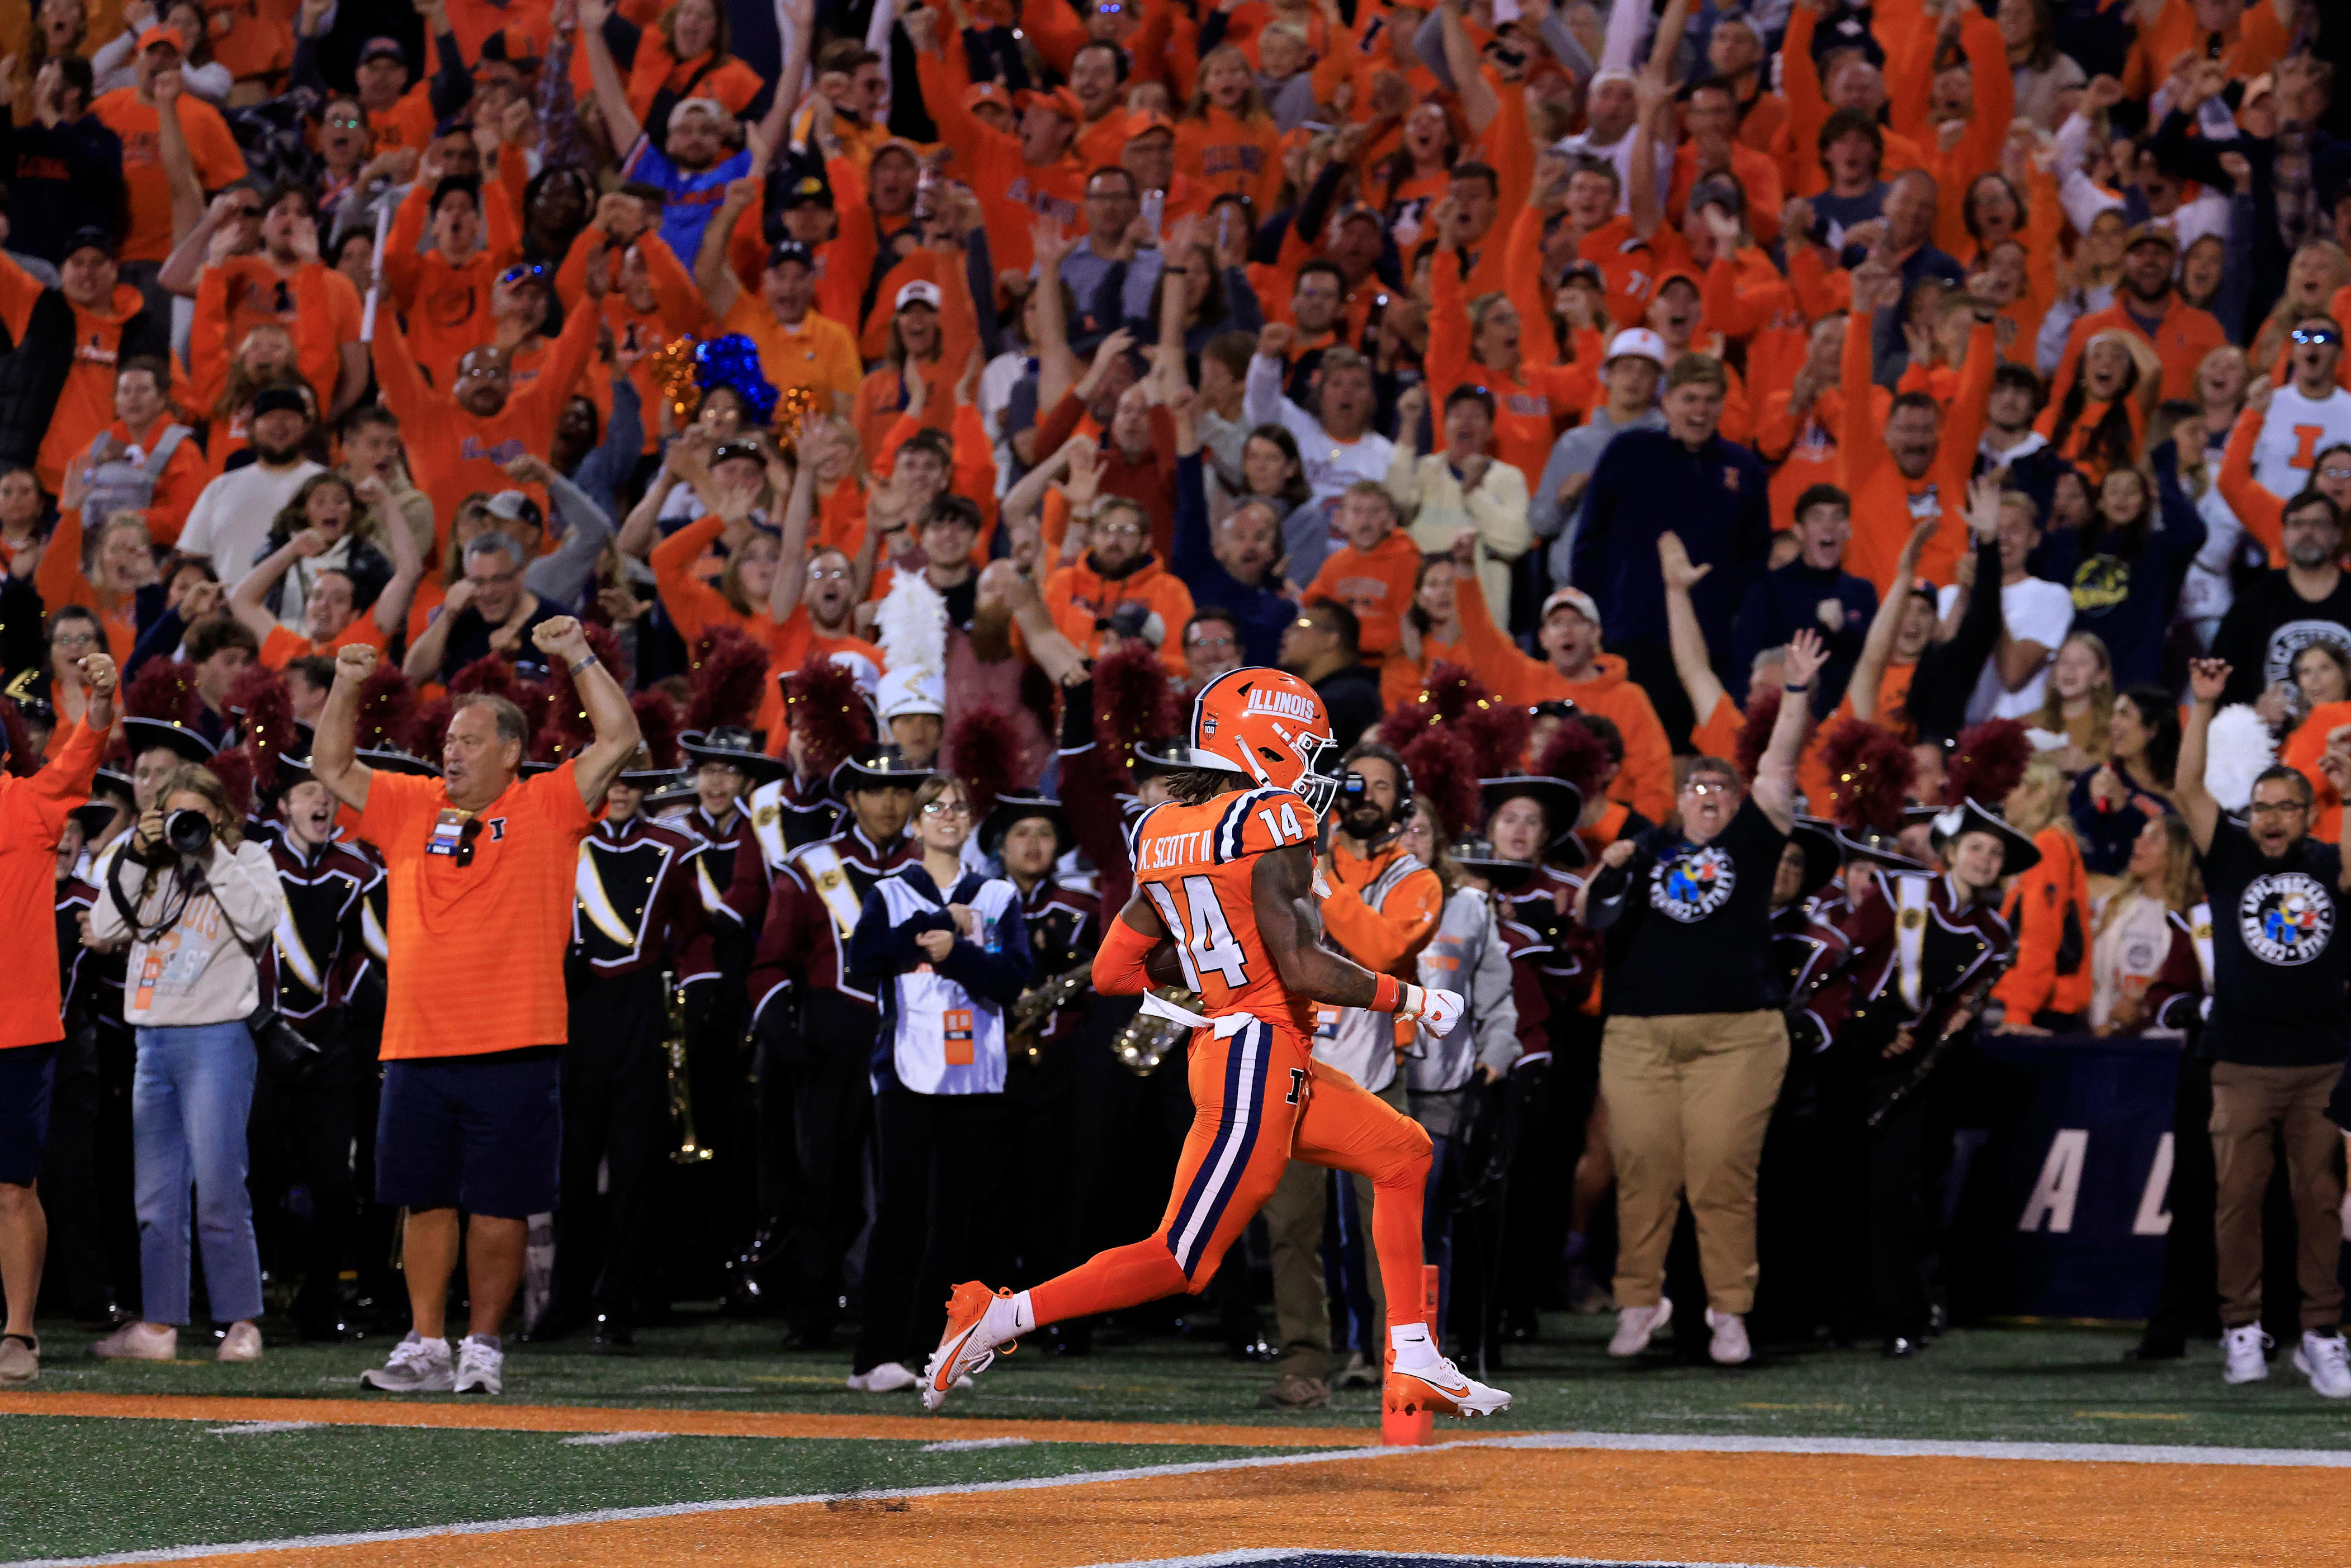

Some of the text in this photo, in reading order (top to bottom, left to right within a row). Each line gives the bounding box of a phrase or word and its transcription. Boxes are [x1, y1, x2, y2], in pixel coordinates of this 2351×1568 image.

[2288, 425, 2324, 469] I
[1247, 688, 1315, 720] ILLINOIS
[1204, 725, 1215, 734] 100
[488, 816, 507, 843] I
[1257, 801, 1304, 848] 14
[1152, 831, 1200, 869] SCOTT
[1200, 828, 1212, 862] II
[1143, 874, 1251, 995] 14
[1285, 1067, 1304, 1106] I
[2017, 1128, 2090, 1234] A
